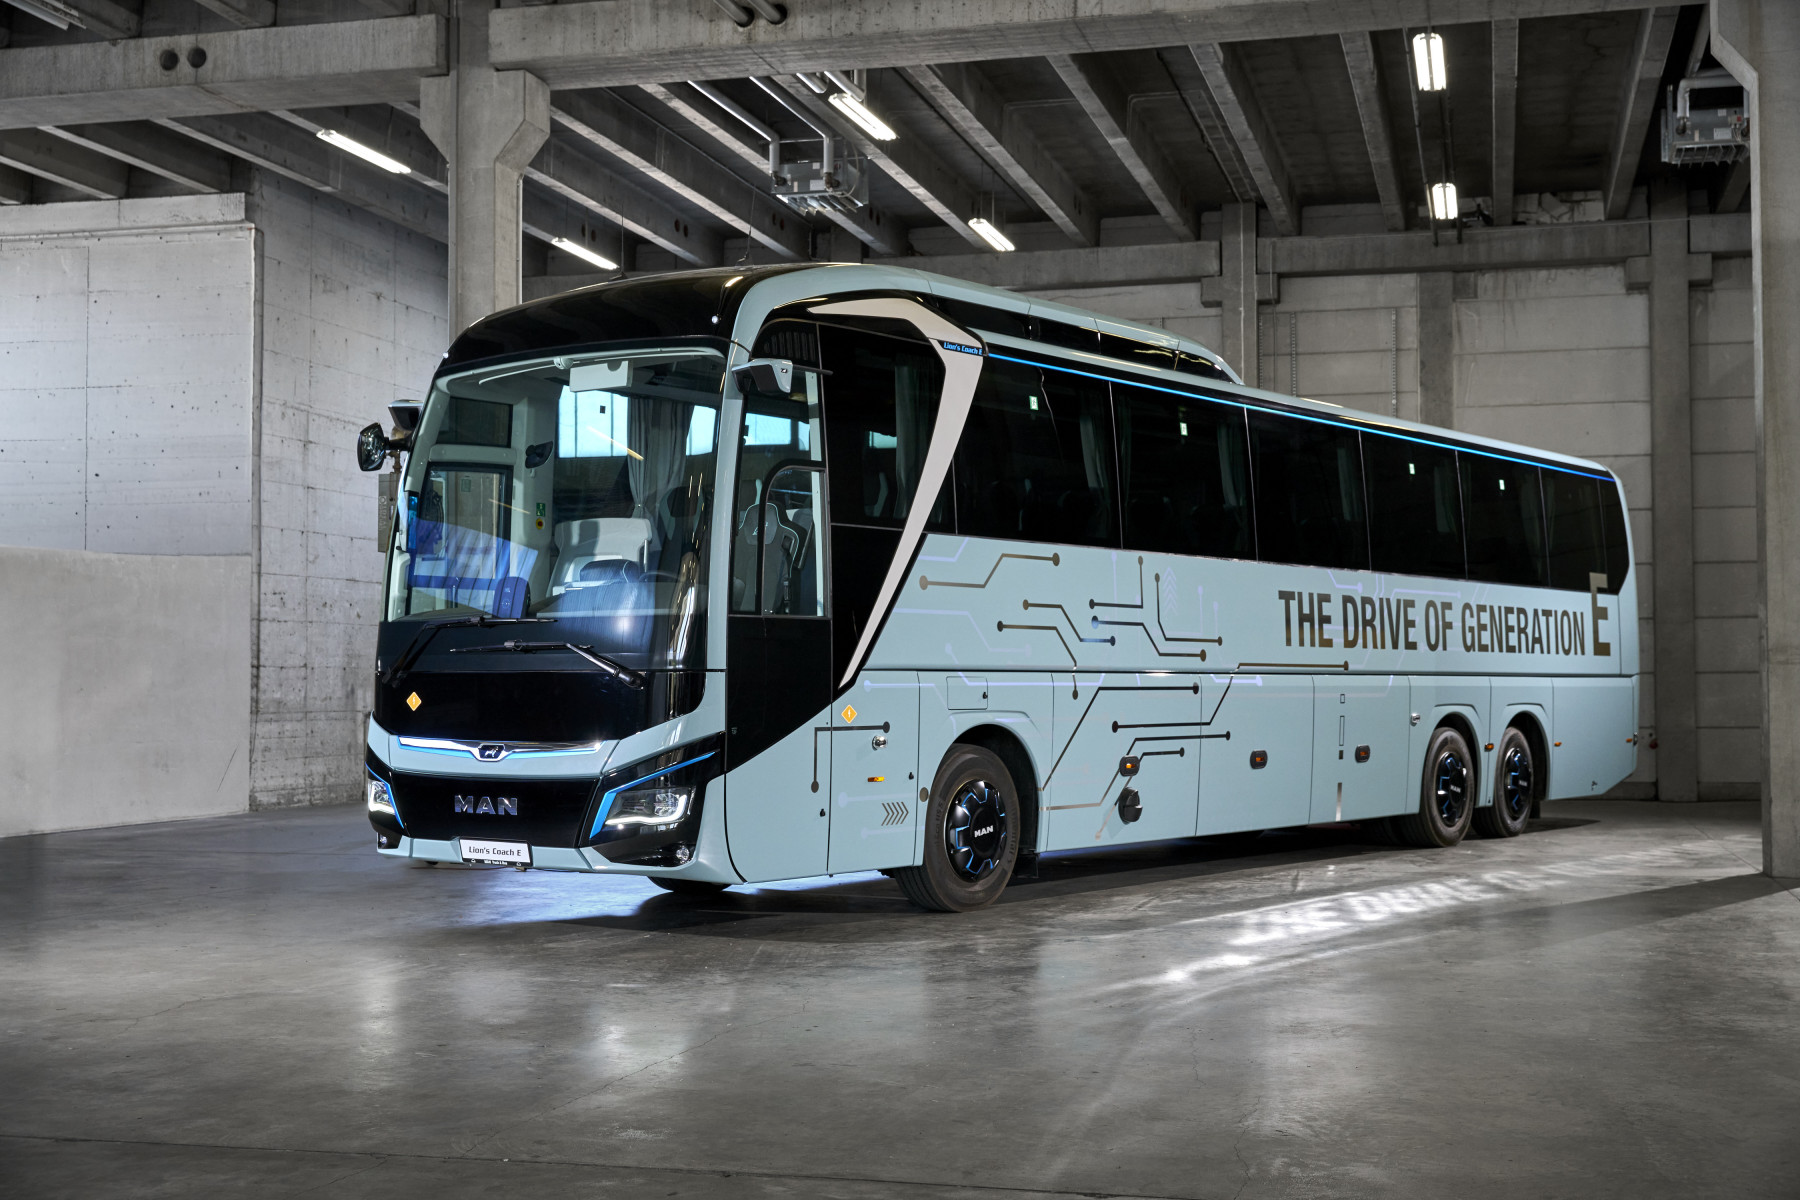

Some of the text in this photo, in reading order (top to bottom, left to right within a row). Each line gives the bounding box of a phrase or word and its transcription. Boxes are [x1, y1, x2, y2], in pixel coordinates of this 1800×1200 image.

[943, 341, 961, 351] Lion's
[961, 345, 978, 355] Coach
[1278, 571, 1611, 657] THE DRIVE OF GENERATION E
[454, 794, 518, 816] MAN
[974, 825, 994, 838] MAN
[468, 846, 490, 854] Lion's
[492, 847, 515, 856] Coach
